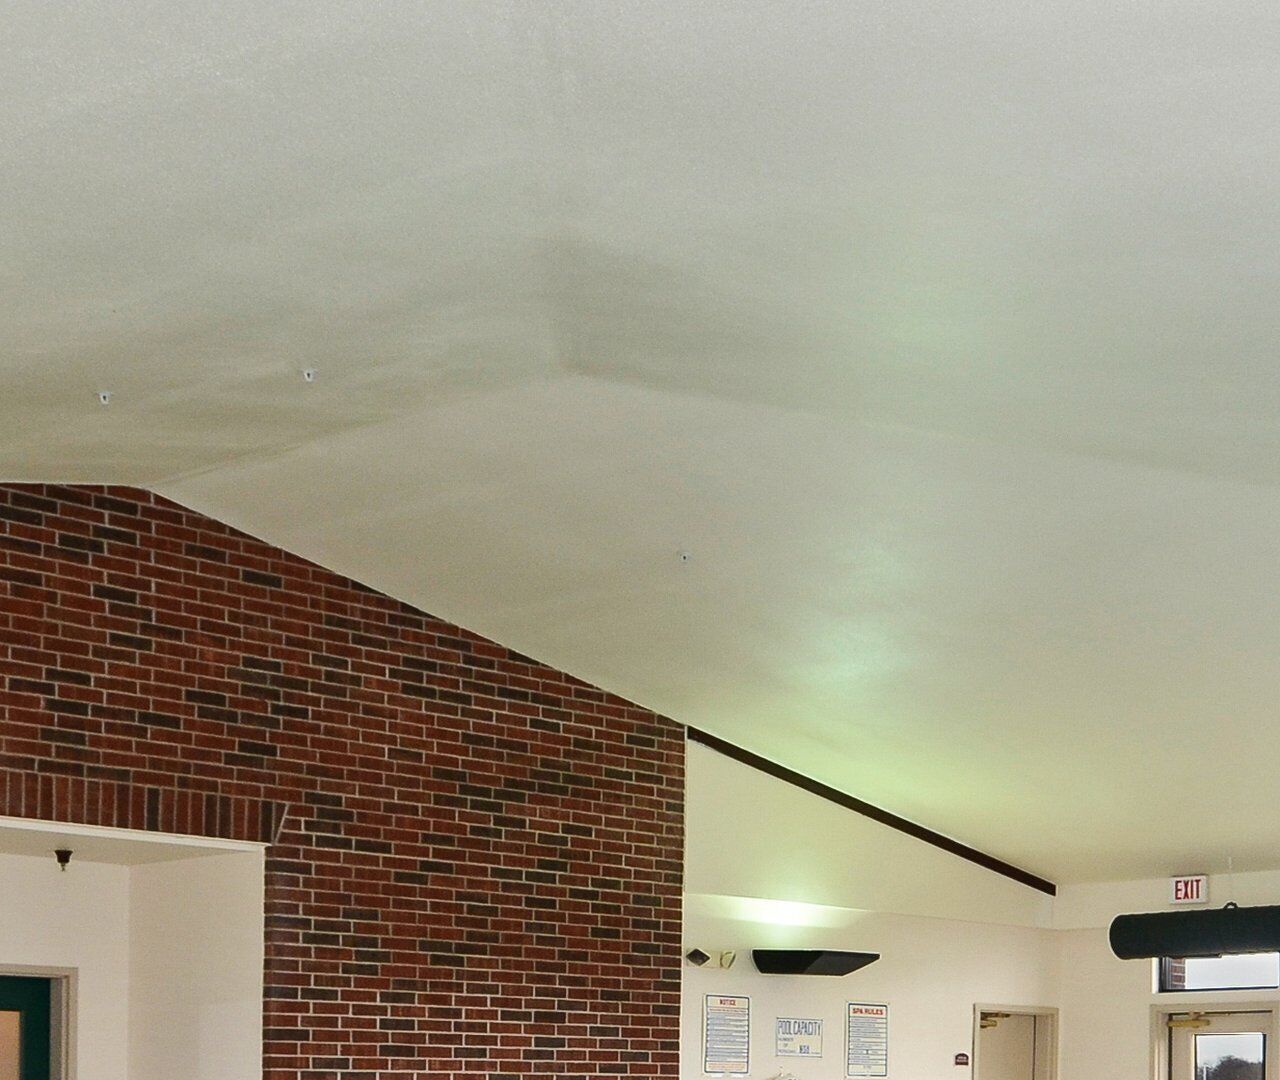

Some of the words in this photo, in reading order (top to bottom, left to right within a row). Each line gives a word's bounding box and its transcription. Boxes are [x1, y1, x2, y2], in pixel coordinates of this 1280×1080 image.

[1175, 879, 1201, 900] EXIT
[778, 1020, 793, 1035] POOL
[793, 1020, 821, 1036] CAPACITY
